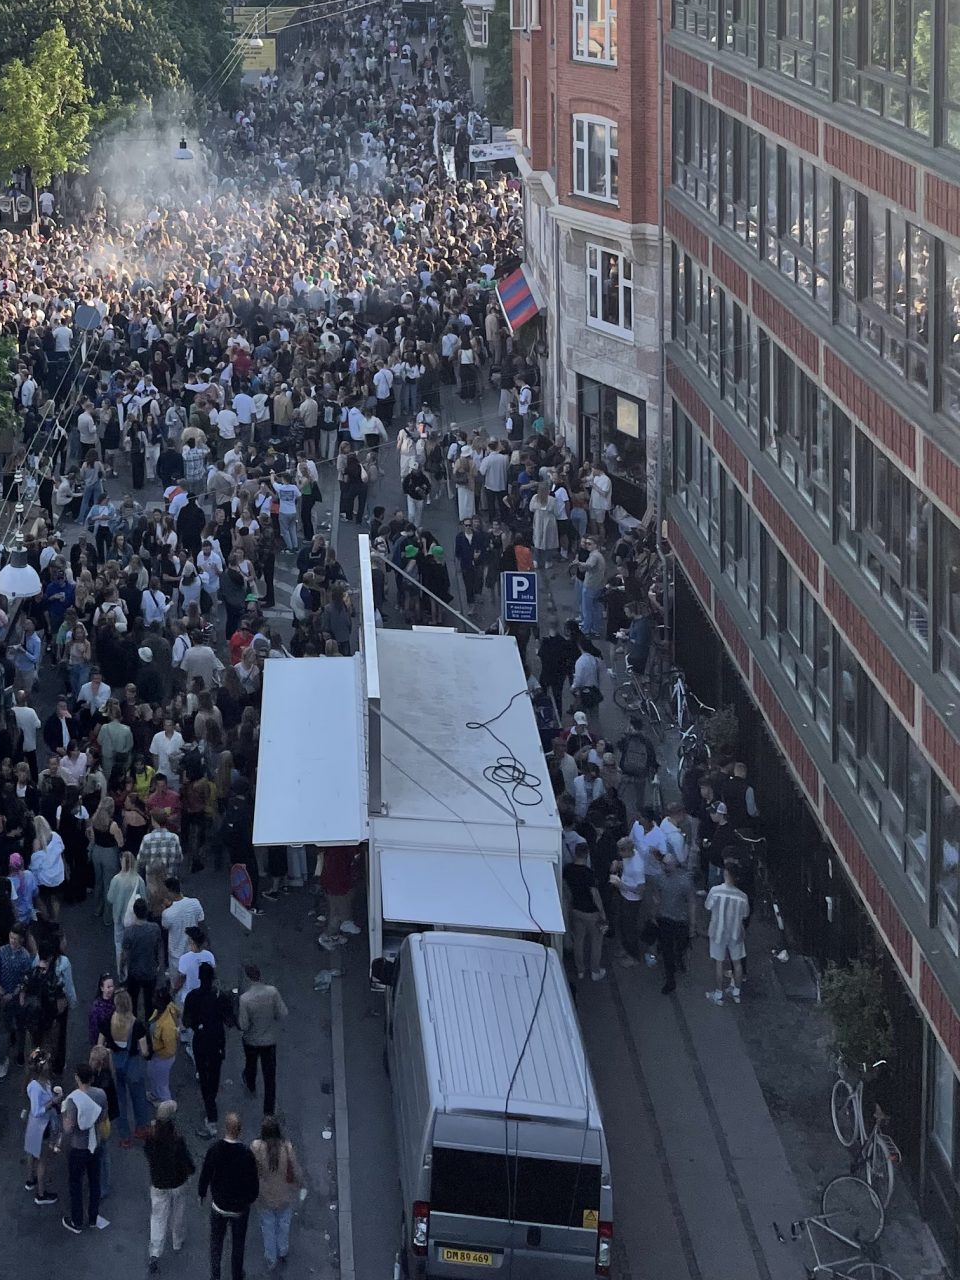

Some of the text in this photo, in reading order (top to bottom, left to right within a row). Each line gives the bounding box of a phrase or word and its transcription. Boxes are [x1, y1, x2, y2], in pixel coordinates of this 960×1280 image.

[512, 576, 530, 599] P
[446, 1250, 489, 1263] DM 89 469
